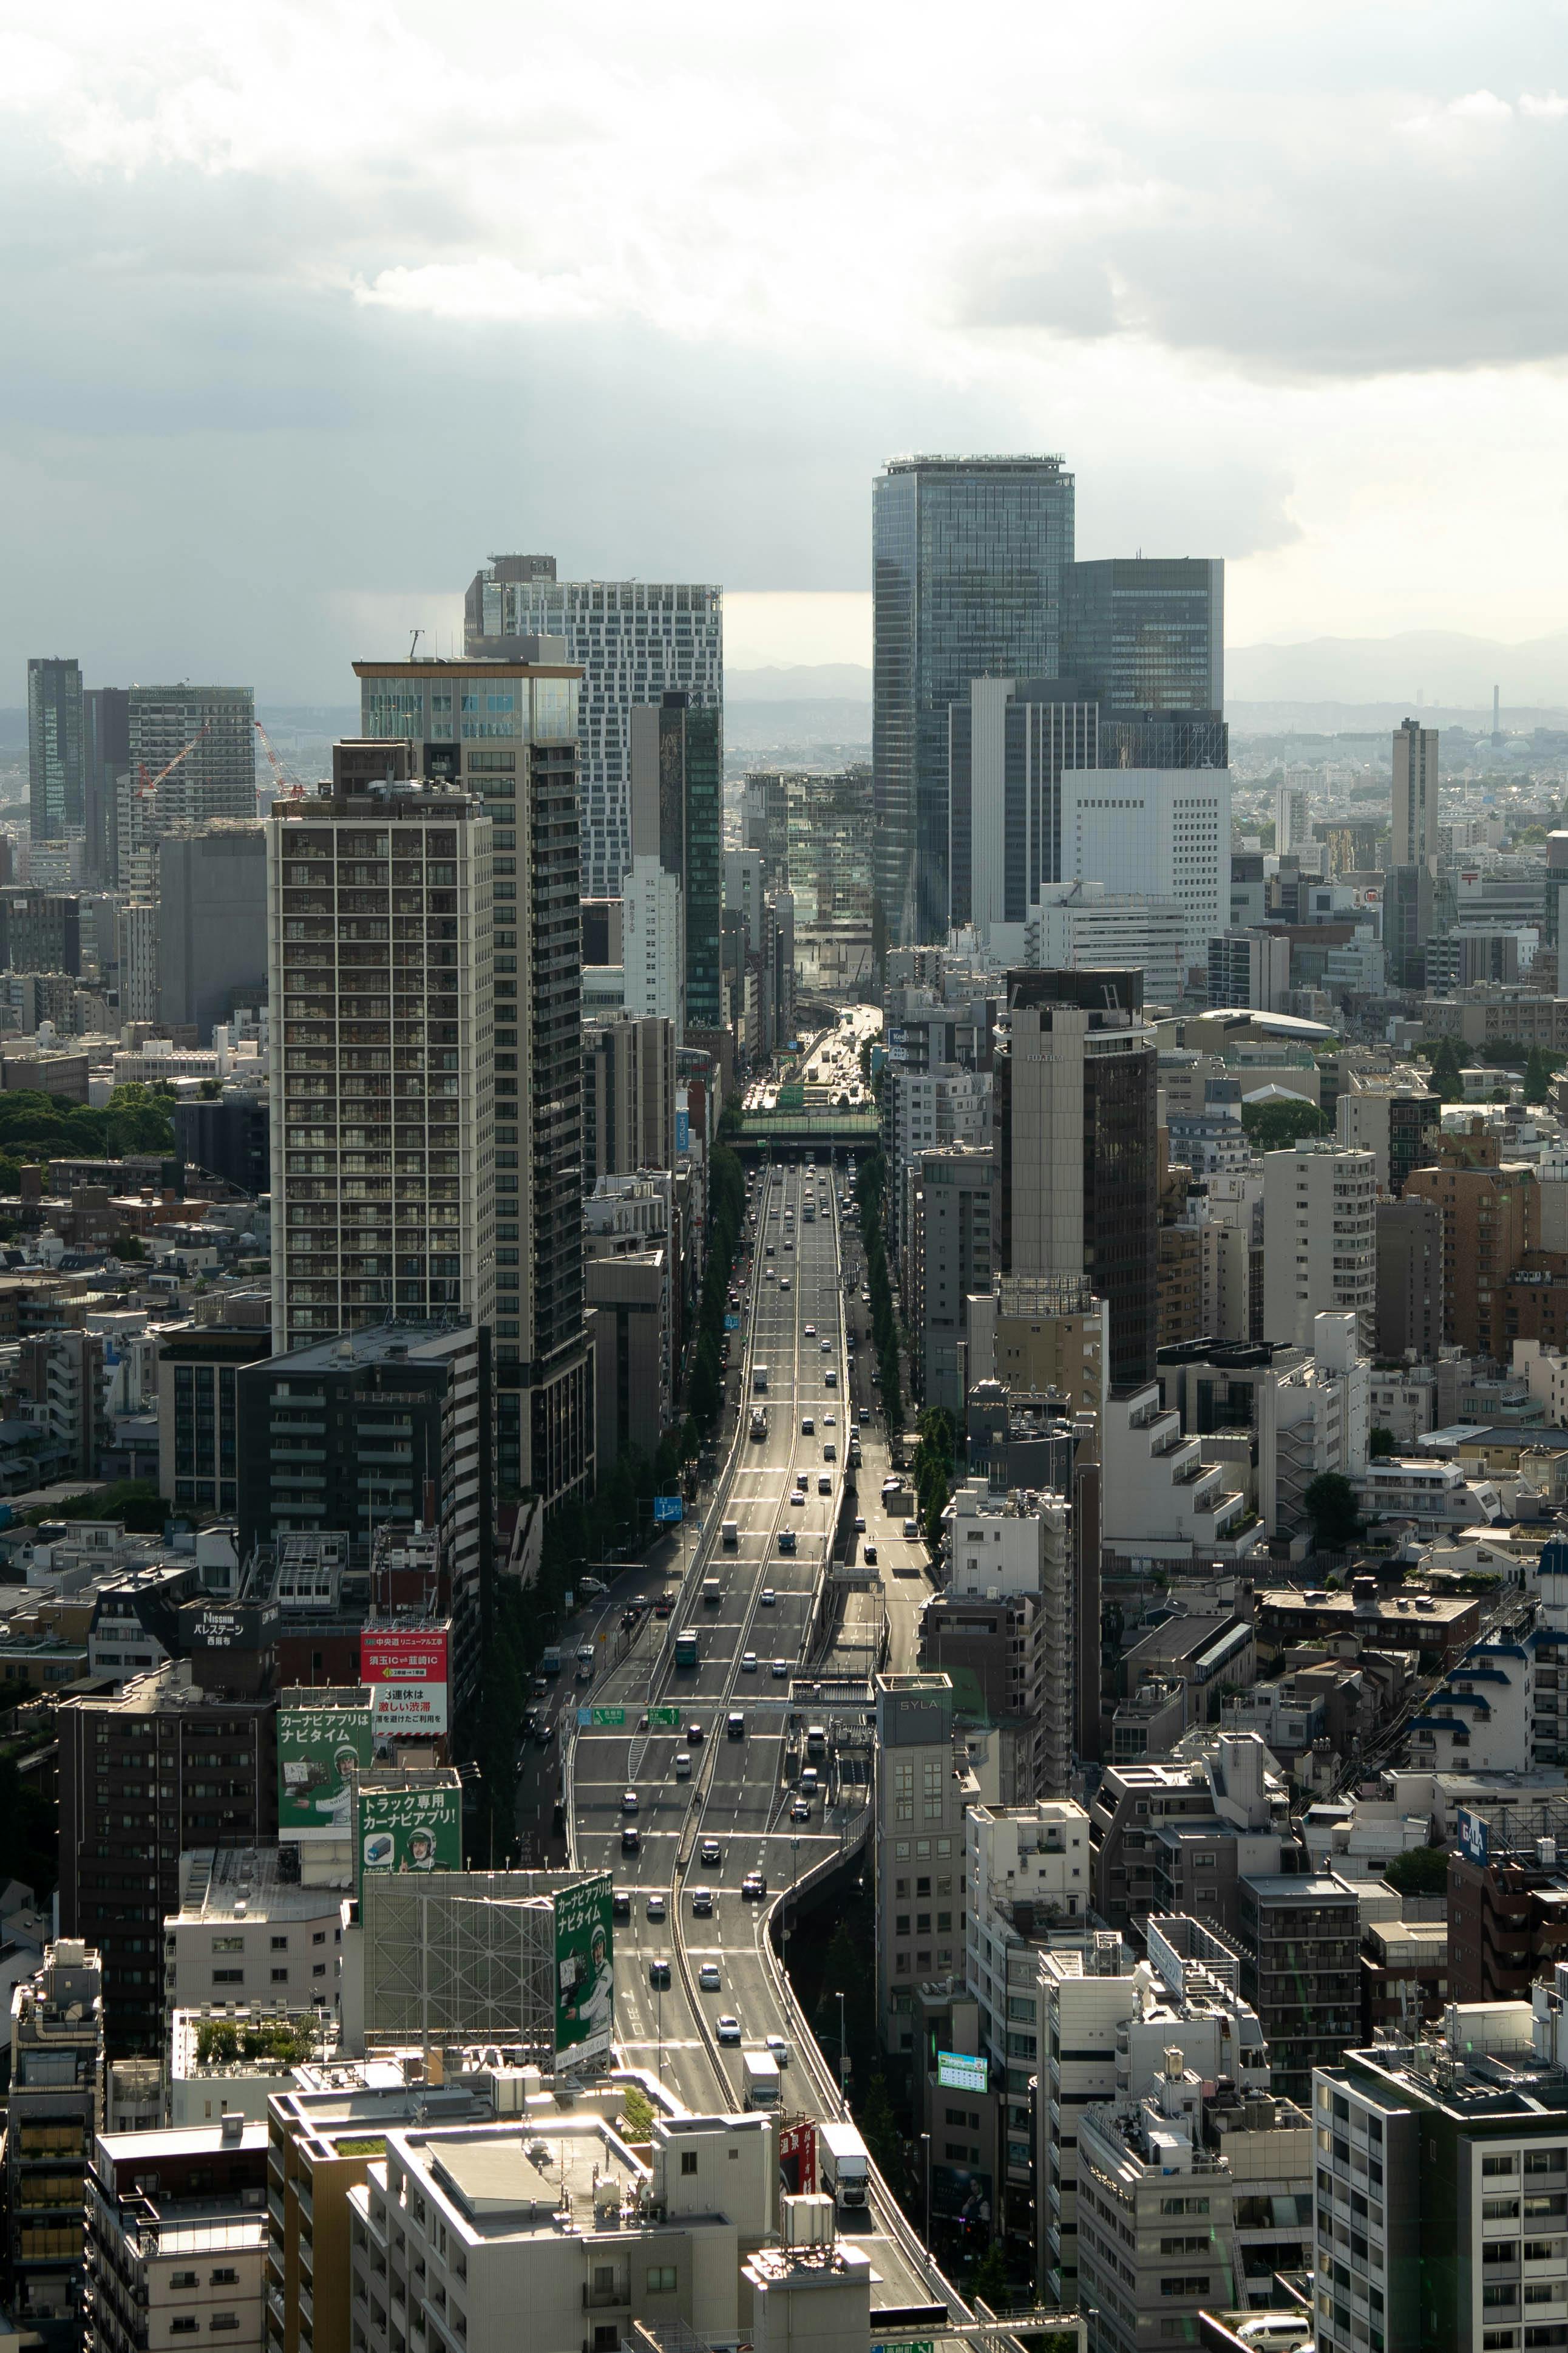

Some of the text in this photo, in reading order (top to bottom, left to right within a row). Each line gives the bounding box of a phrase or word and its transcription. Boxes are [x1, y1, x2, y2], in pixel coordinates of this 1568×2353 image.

[194, 1624, 243, 1636] パレステージ
[207, 1636, 231, 1646] 西麻布
[376, 1638, 399, 1646] 中央道
[369, 1656, 399, 1665] 須玉IC
[385, 1689, 424, 1700] 3連休は
[378, 1702, 430, 1712] 激しい渋滞
[900, 1700, 938, 1711] SYLA
[281, 1729, 350, 1743] ナビタイム
[366, 1793, 444, 1814] トラック専用
[363, 1809, 455, 1830] カーナビアプリ!
[1462, 1823, 1484, 1851] GALA
[558, 1880, 612, 1915] カーナビアプリは
[558, 1904, 601, 1936] ナビタイム
[781, 2134, 799, 2155] 温泉
